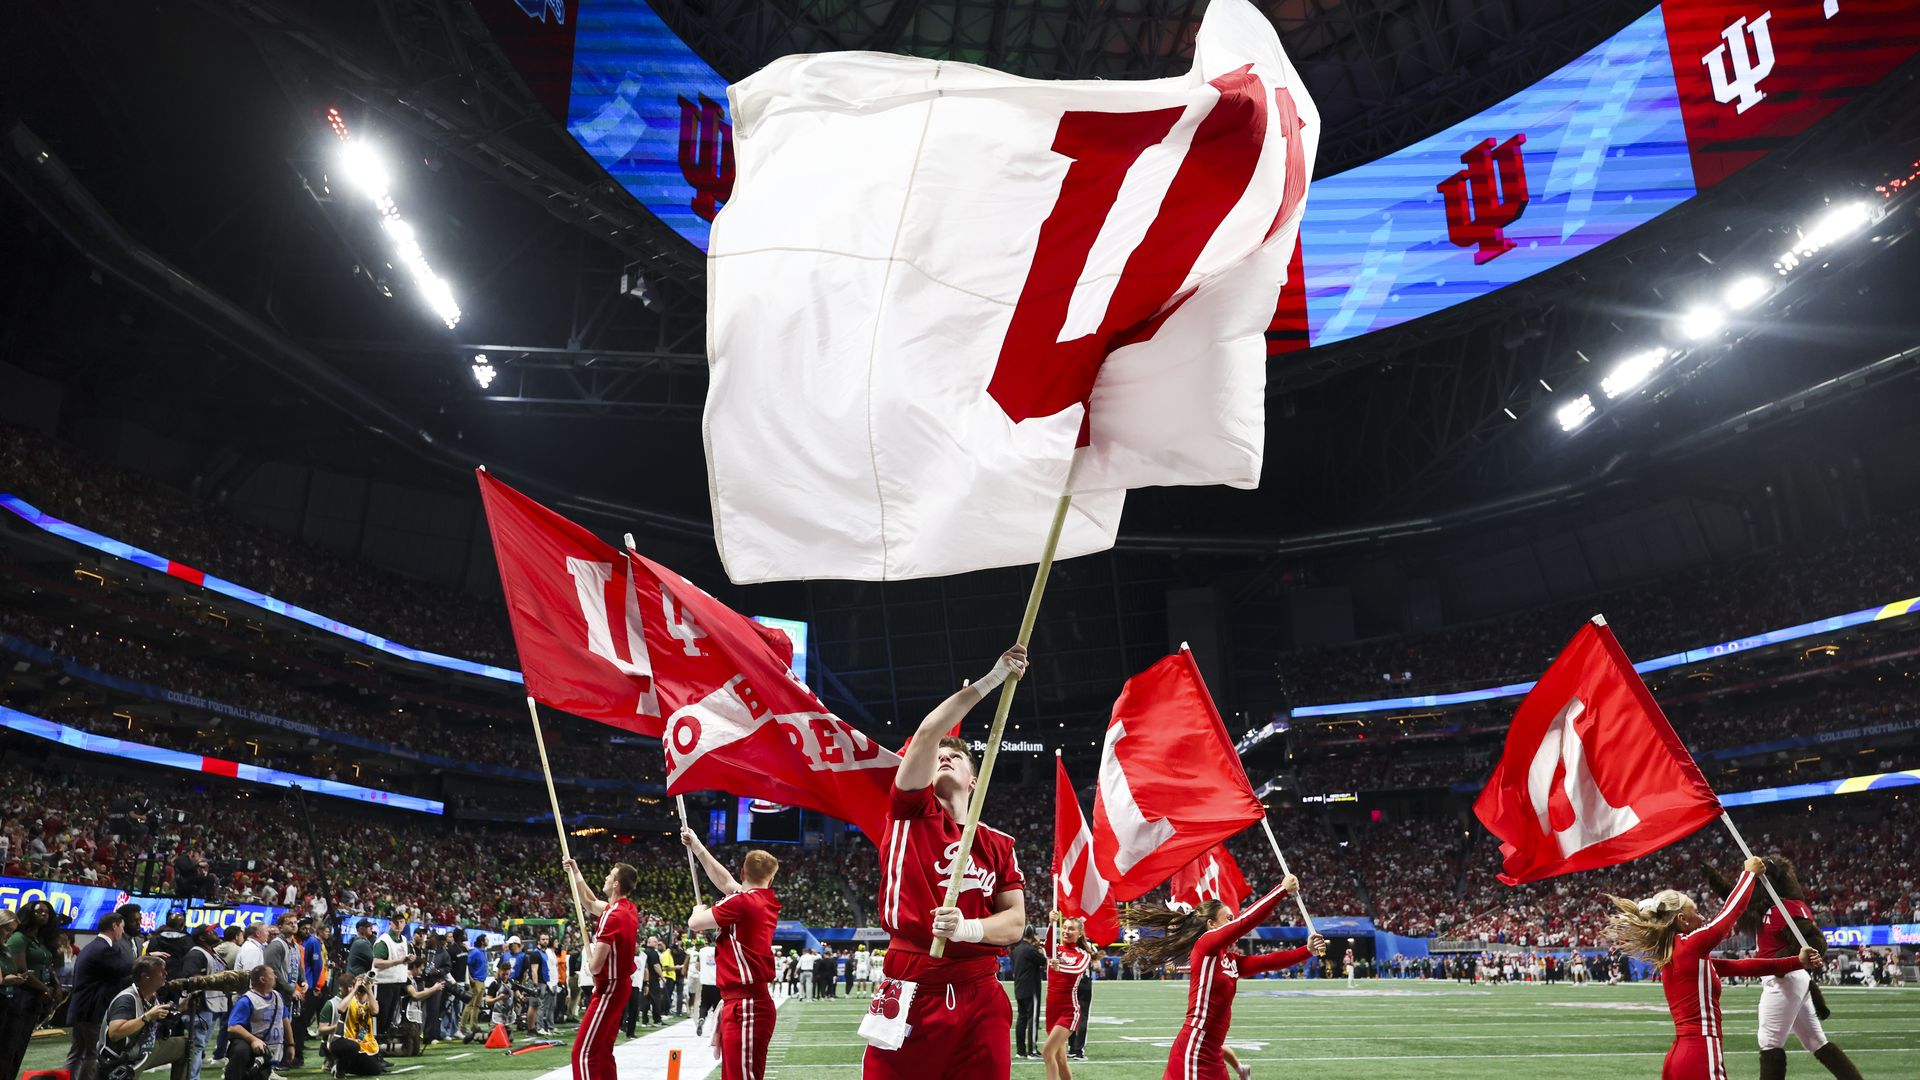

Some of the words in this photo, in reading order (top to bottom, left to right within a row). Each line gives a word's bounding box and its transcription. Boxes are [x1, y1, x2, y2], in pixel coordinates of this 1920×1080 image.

[167, 690, 207, 709] COLLEGE
[208, 700, 250, 720] FOOTBALL
[250, 711, 282, 728] PLAYOFF
[1001, 740, 1043, 752] Stadium
[186, 908, 267, 931] DUCKS
